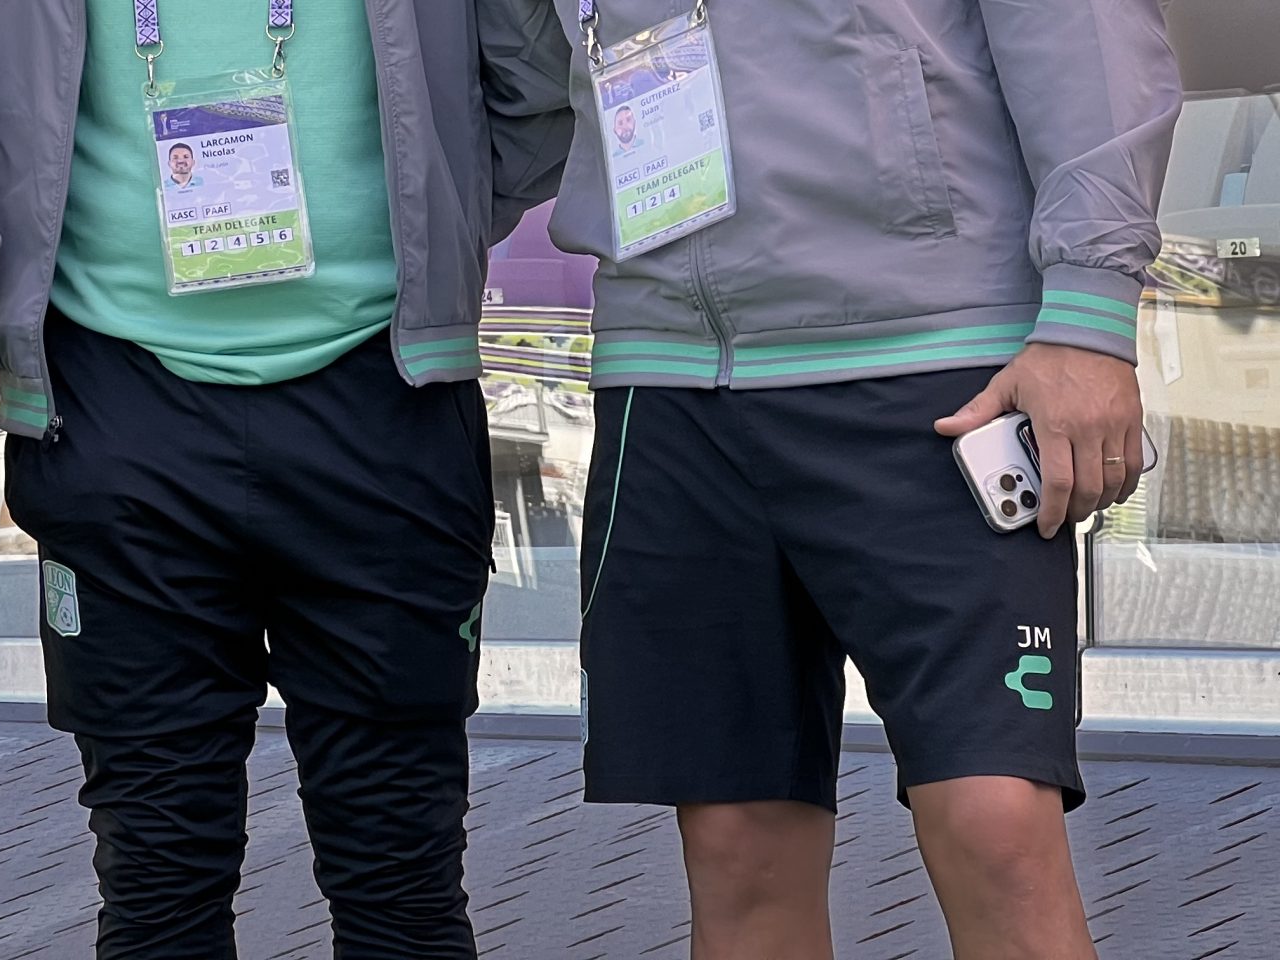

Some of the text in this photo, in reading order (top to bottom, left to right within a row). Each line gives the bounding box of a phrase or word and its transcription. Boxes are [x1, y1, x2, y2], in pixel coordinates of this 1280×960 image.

[642, 105, 660, 119] Juan
[200, 134, 254, 148] LARCAMON
[202, 148, 236, 158] Nicolas
[618, 160, 666, 186] KASC PAAF
[636, 158, 704, 196] TEAM DELEGATE
[632, 188, 676, 214] 1 2 4
[171, 206, 228, 220] KASC PAAF
[193, 216, 278, 235] TEAM DELEGATE
[188, 230, 287, 254] 1 2 4 5 6
[1230, 242, 1246, 255] 20
[1017, 626, 1052, 649] JM
